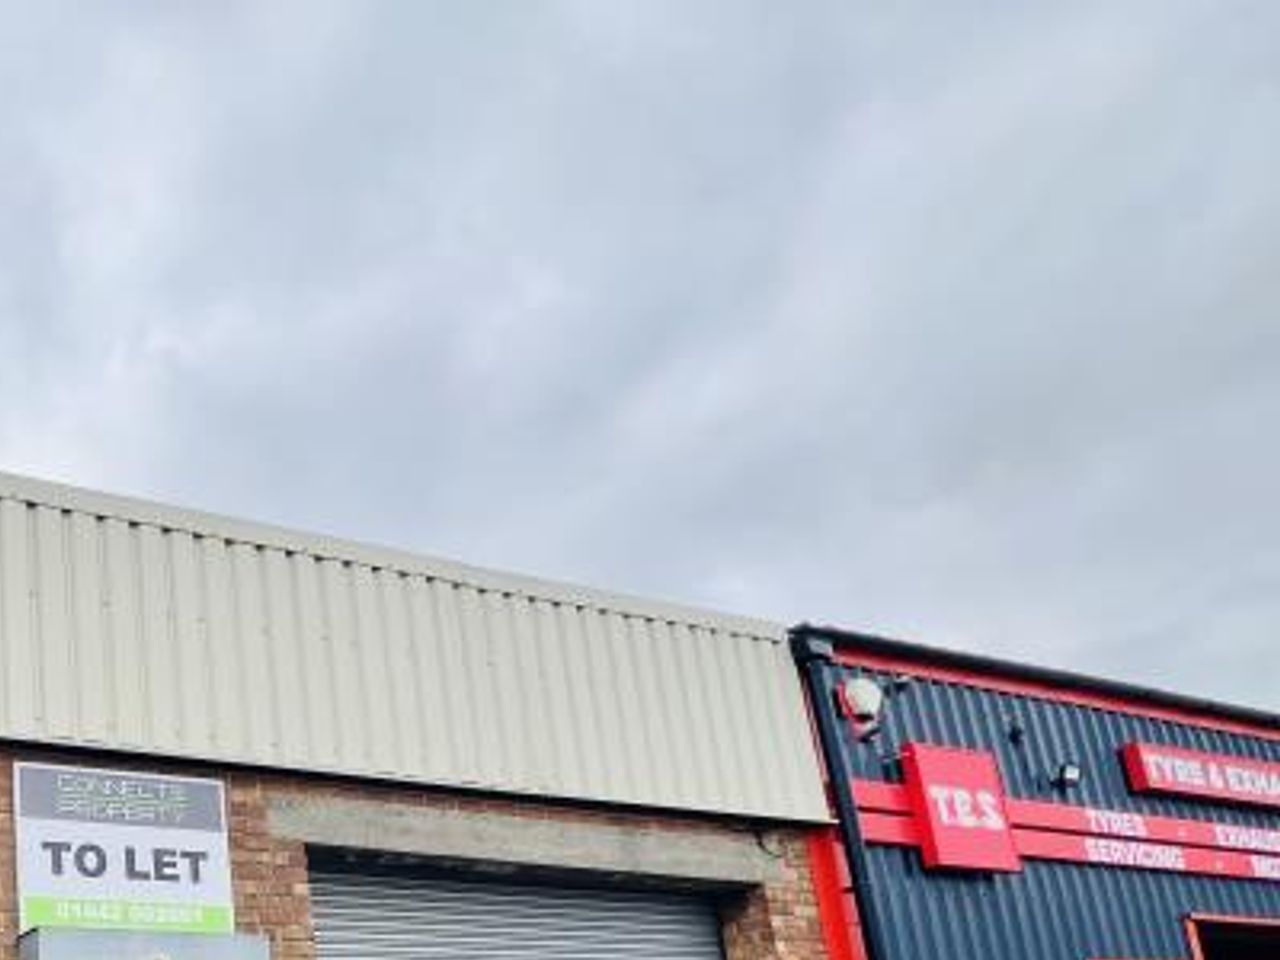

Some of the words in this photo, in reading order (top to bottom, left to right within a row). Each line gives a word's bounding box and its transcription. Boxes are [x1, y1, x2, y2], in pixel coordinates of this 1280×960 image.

[1144, 753, 1207, 787] TYRE
[1086, 808, 1147, 836] TYRES
[41, 842, 107, 877] TO
[125, 846, 208, 884] LET
[1085, 838, 1184, 870] SERVICING
